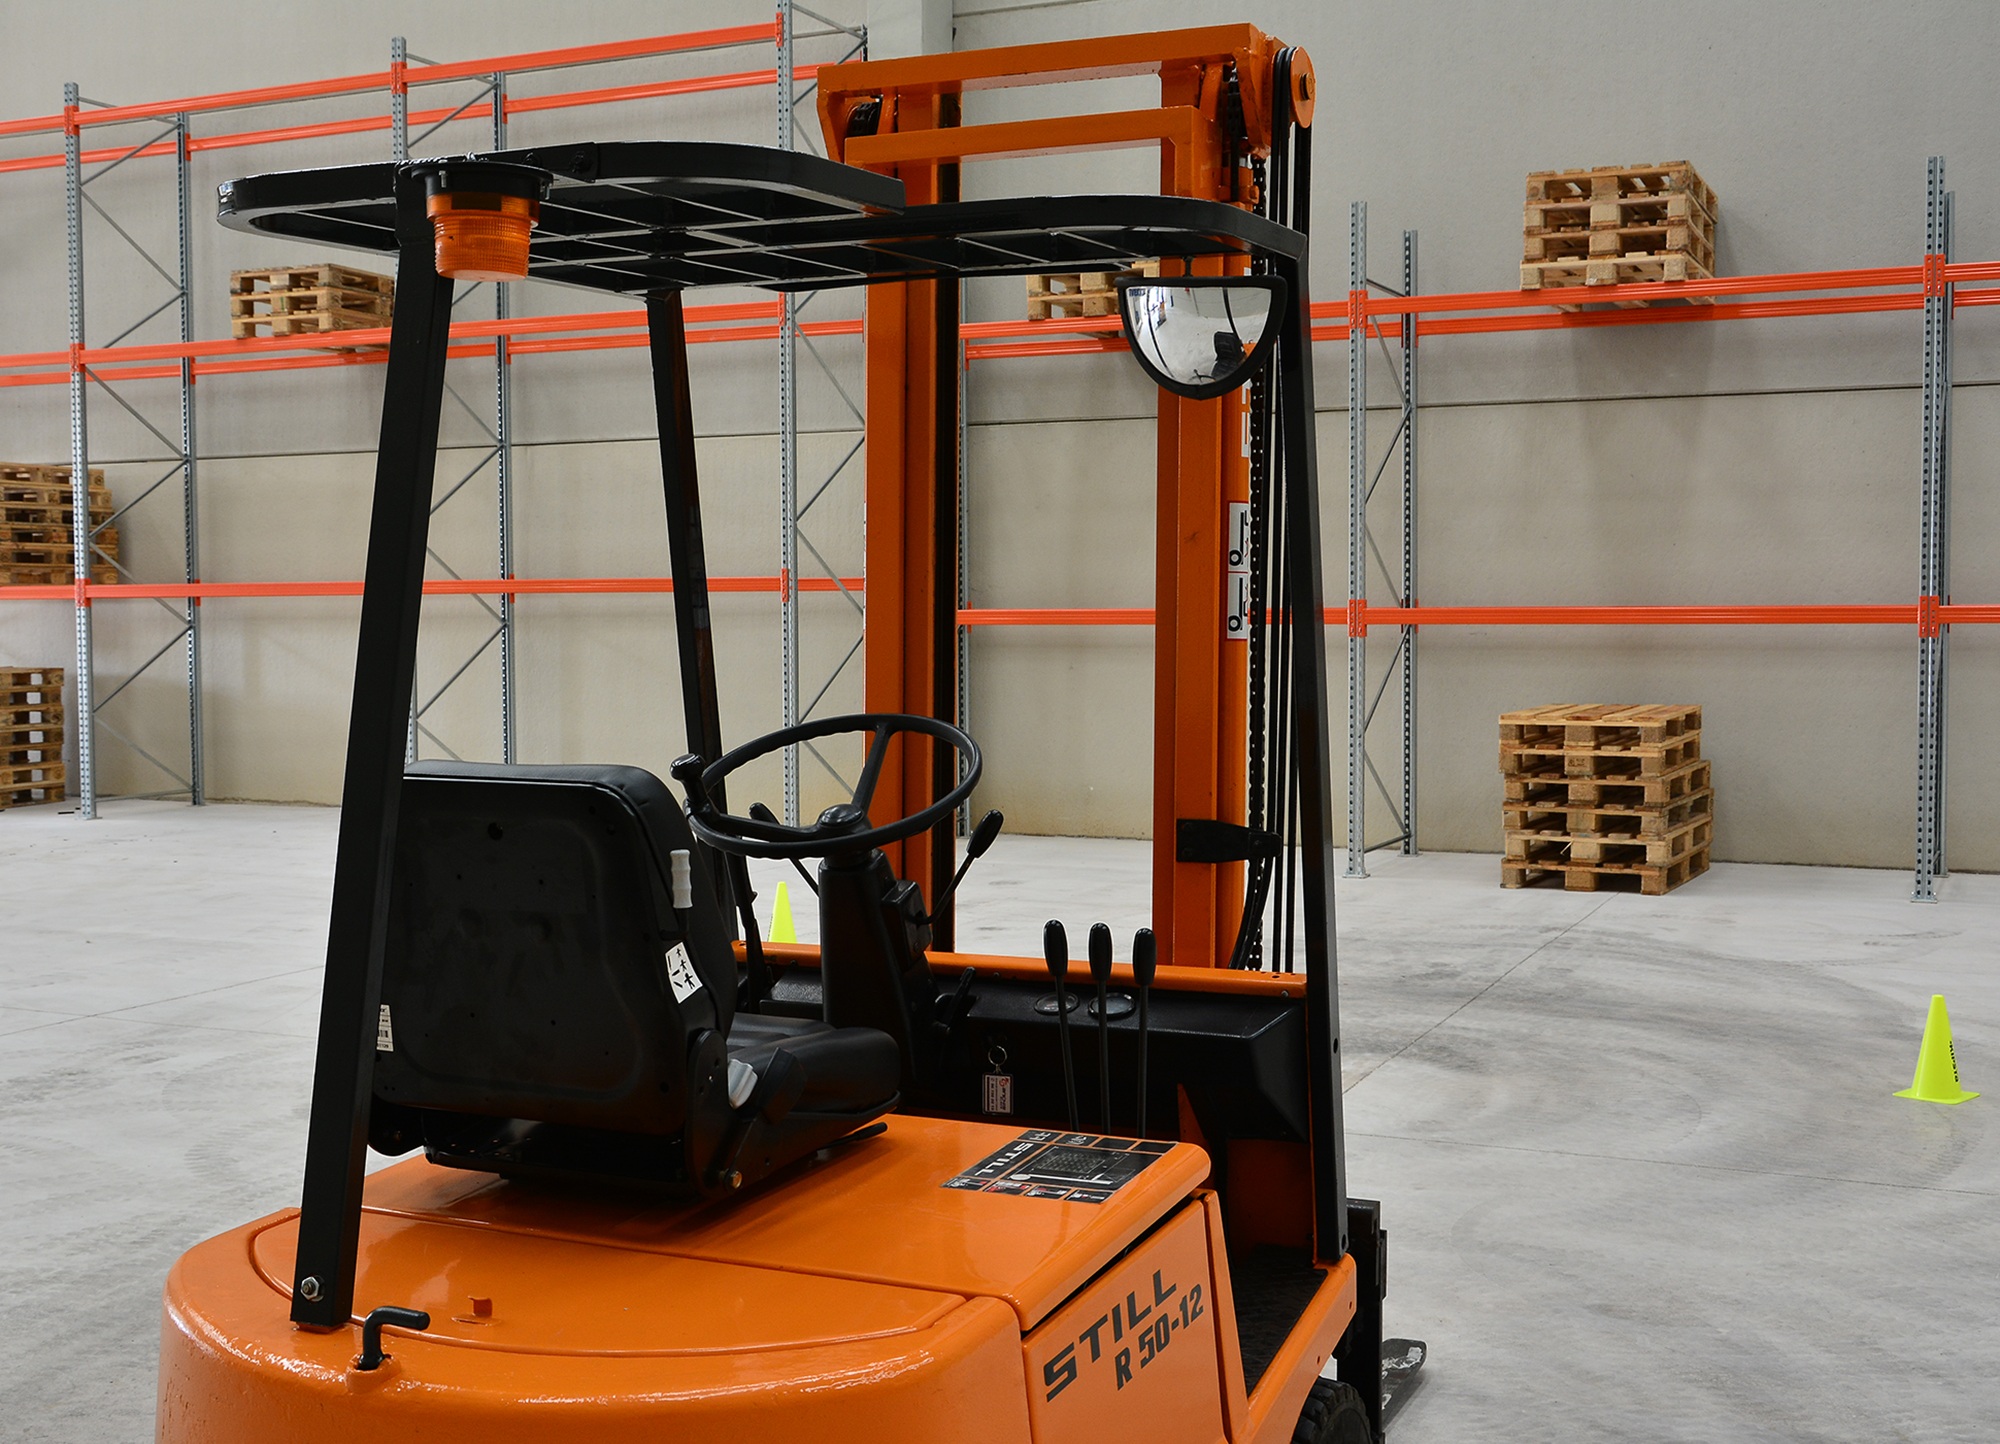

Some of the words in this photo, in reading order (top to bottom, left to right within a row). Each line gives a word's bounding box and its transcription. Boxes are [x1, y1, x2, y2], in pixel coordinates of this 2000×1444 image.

[975, 1142, 1034, 1176] STILL
[1043, 1269, 1177, 1403] STILL
[1114, 1347, 1133, 1391] R
[1139, 1283, 1204, 1370] 50-12
